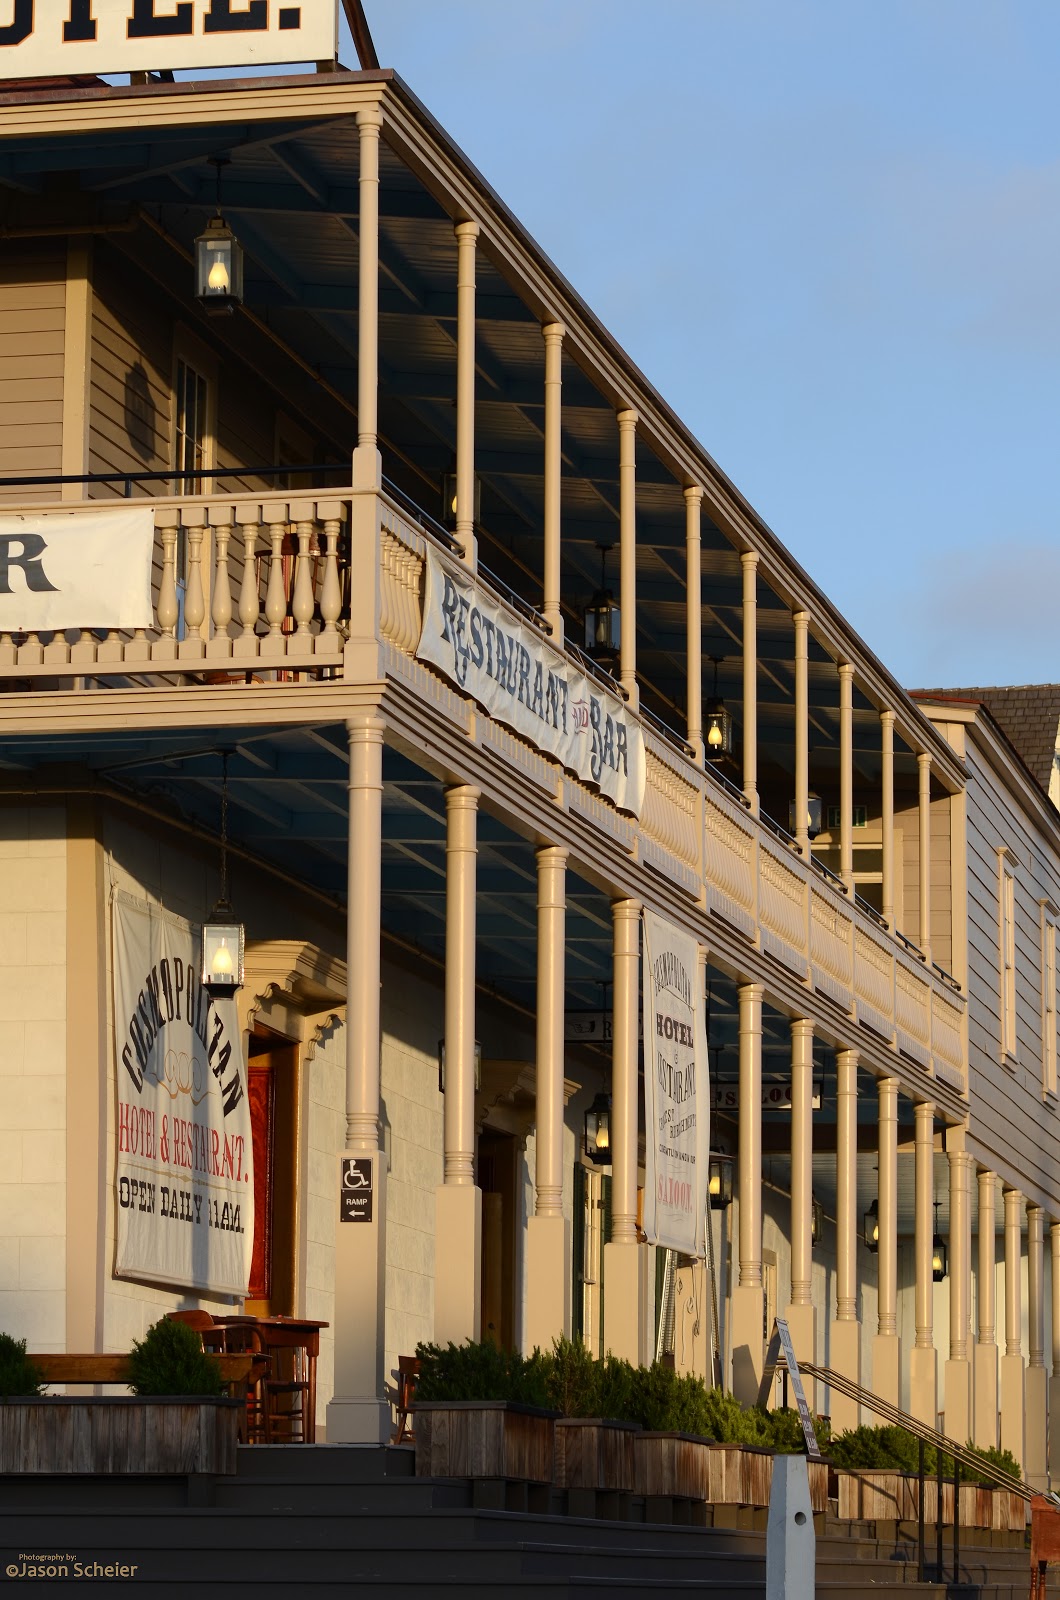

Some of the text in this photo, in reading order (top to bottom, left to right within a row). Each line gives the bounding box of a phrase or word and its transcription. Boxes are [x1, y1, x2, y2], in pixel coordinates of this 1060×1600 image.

[440, 574, 629, 781] RESTAURANT AND BAR
[656, 1012, 694, 1049] HOTEL
[119, 1102, 249, 1184] HOTEL & RESTAURANT.
[119, 1176, 156, 1214] OPEN
[160, 1186, 203, 1225] DAILY
[346, 1198, 368, 1206] RAMP
